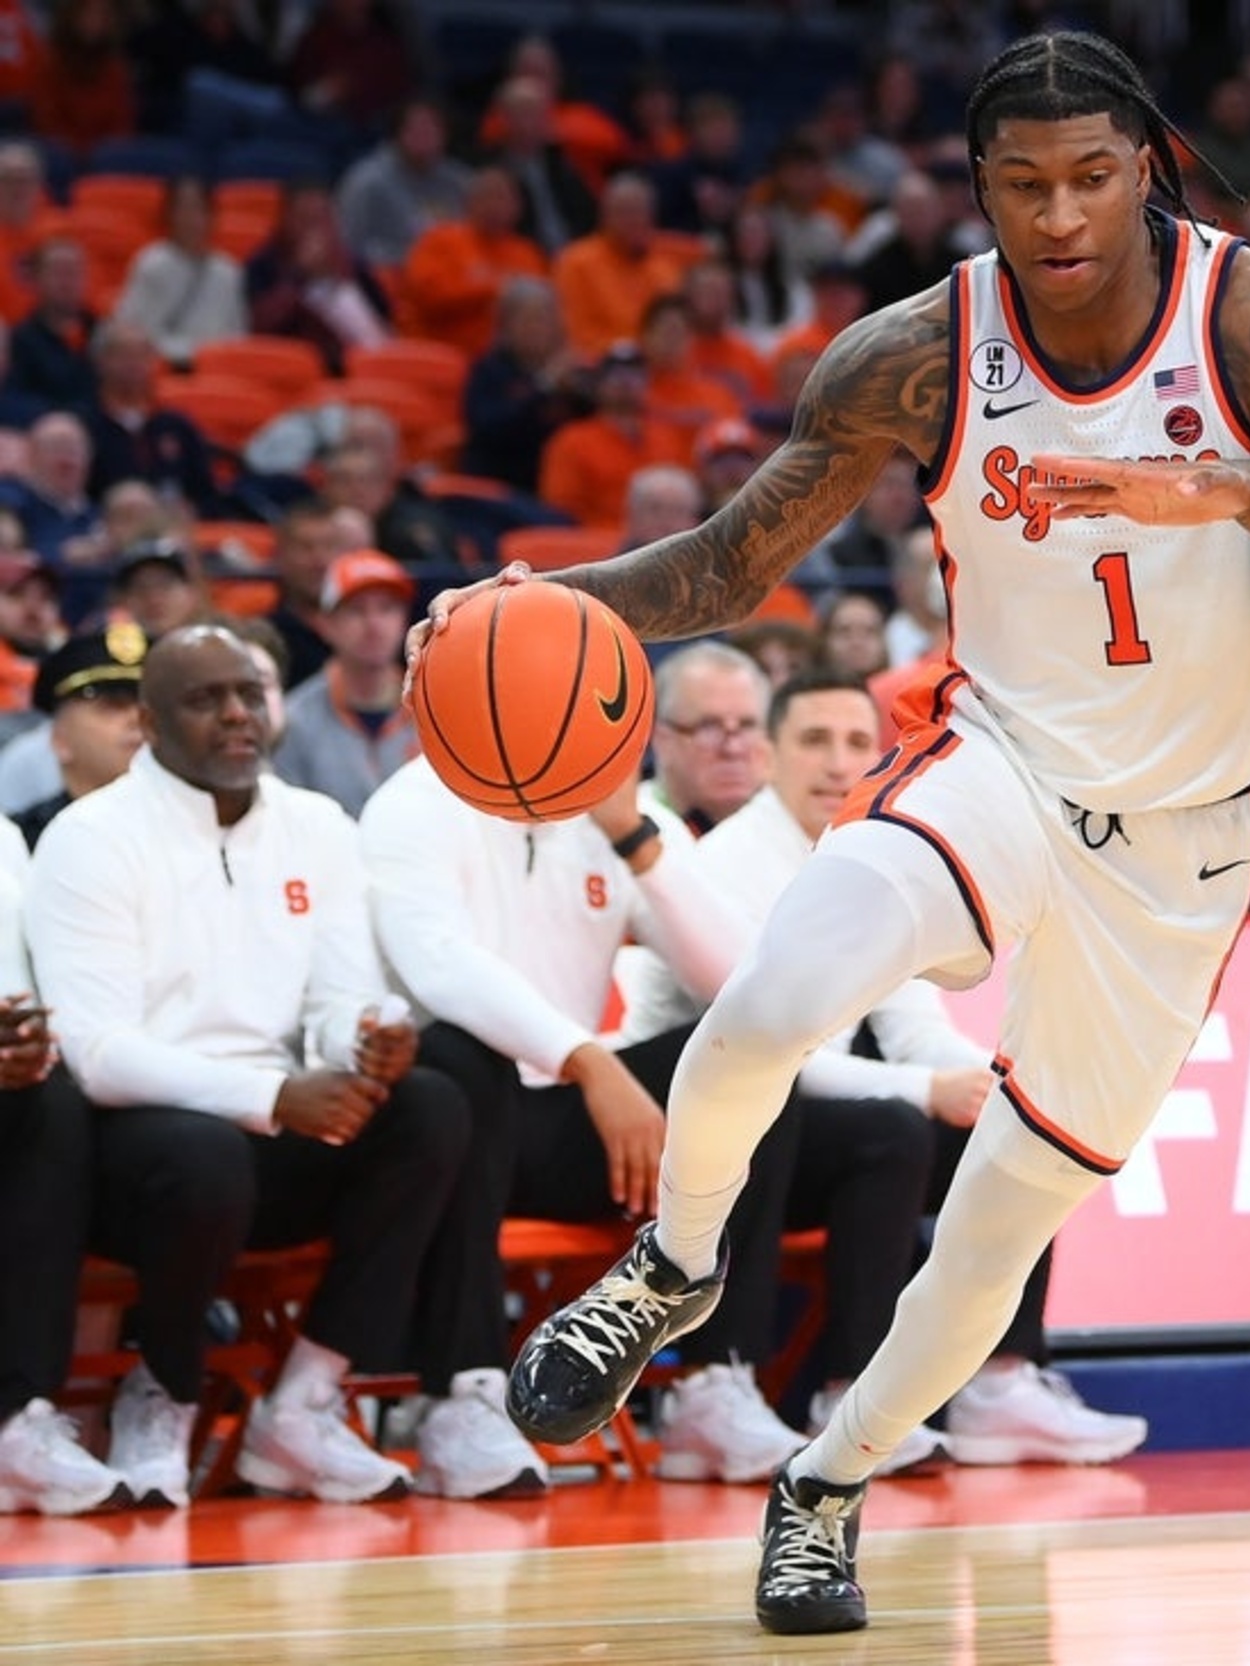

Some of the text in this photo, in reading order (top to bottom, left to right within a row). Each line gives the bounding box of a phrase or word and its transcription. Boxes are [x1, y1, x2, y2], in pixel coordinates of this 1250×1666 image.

[986, 346, 1004, 362] LM
[986, 363, 1004, 386] 21
[1092, 552, 1152, 666] 1
[285, 880, 309, 915] S
[586, 875, 607, 909] S
